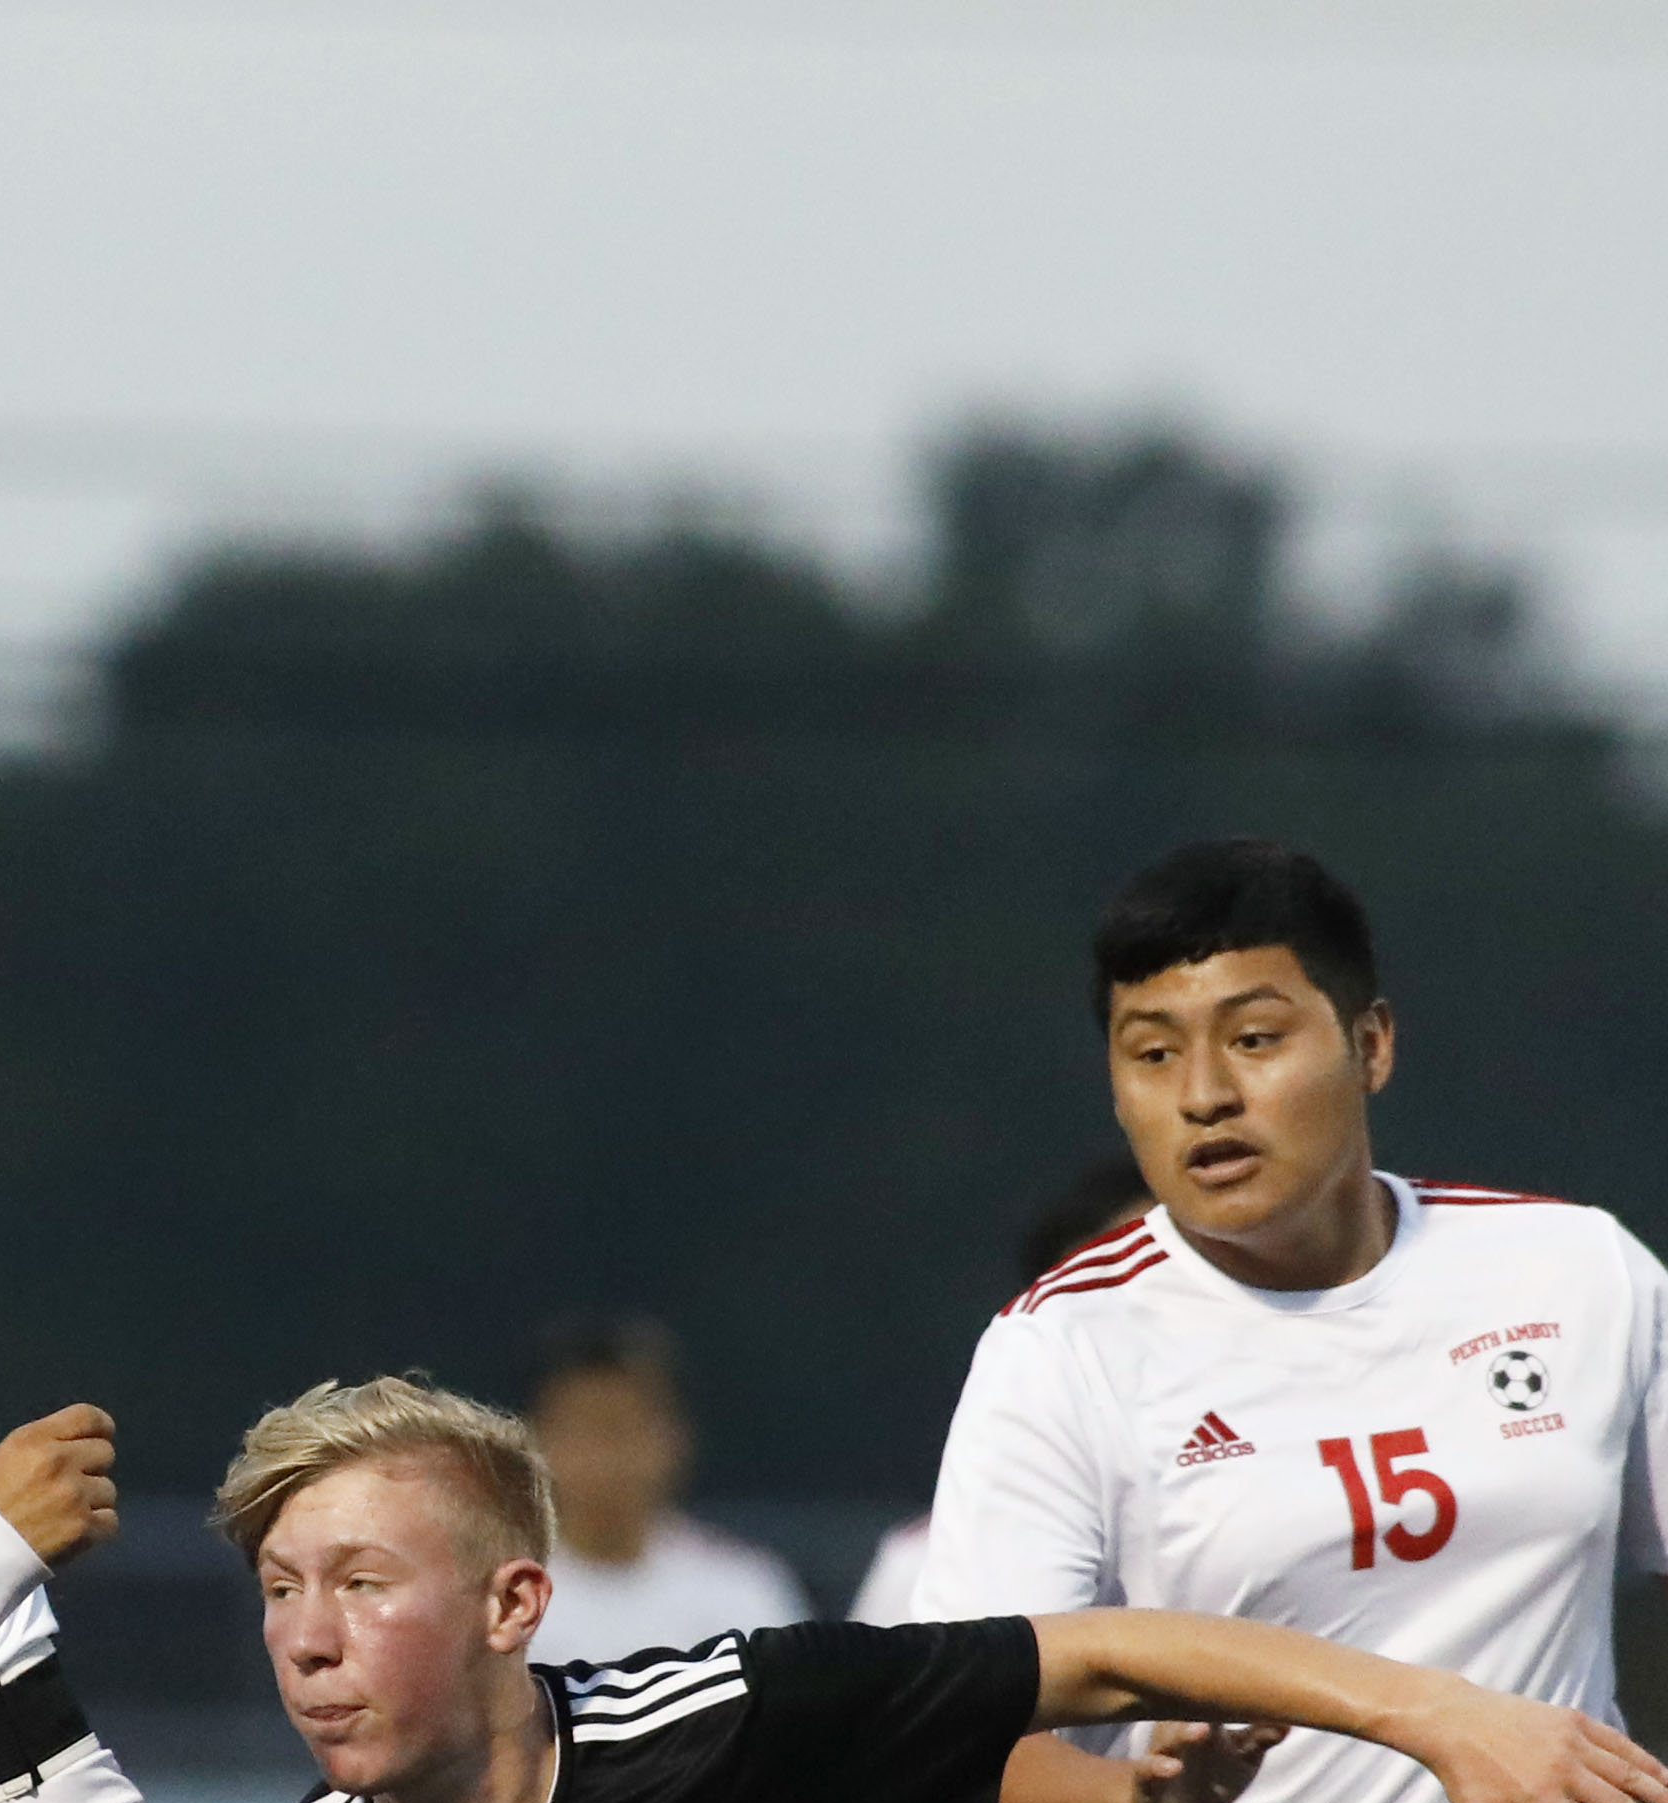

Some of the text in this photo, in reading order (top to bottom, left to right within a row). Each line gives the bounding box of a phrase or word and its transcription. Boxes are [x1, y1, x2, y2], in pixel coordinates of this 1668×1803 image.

[1449, 1322, 1562, 1366] PERTH AMBOY
[1499, 1412, 1565, 1440] SOCCER
[1176, 1441, 1256, 1467] adidas
[1316, 1426, 1459, 1572] 15
